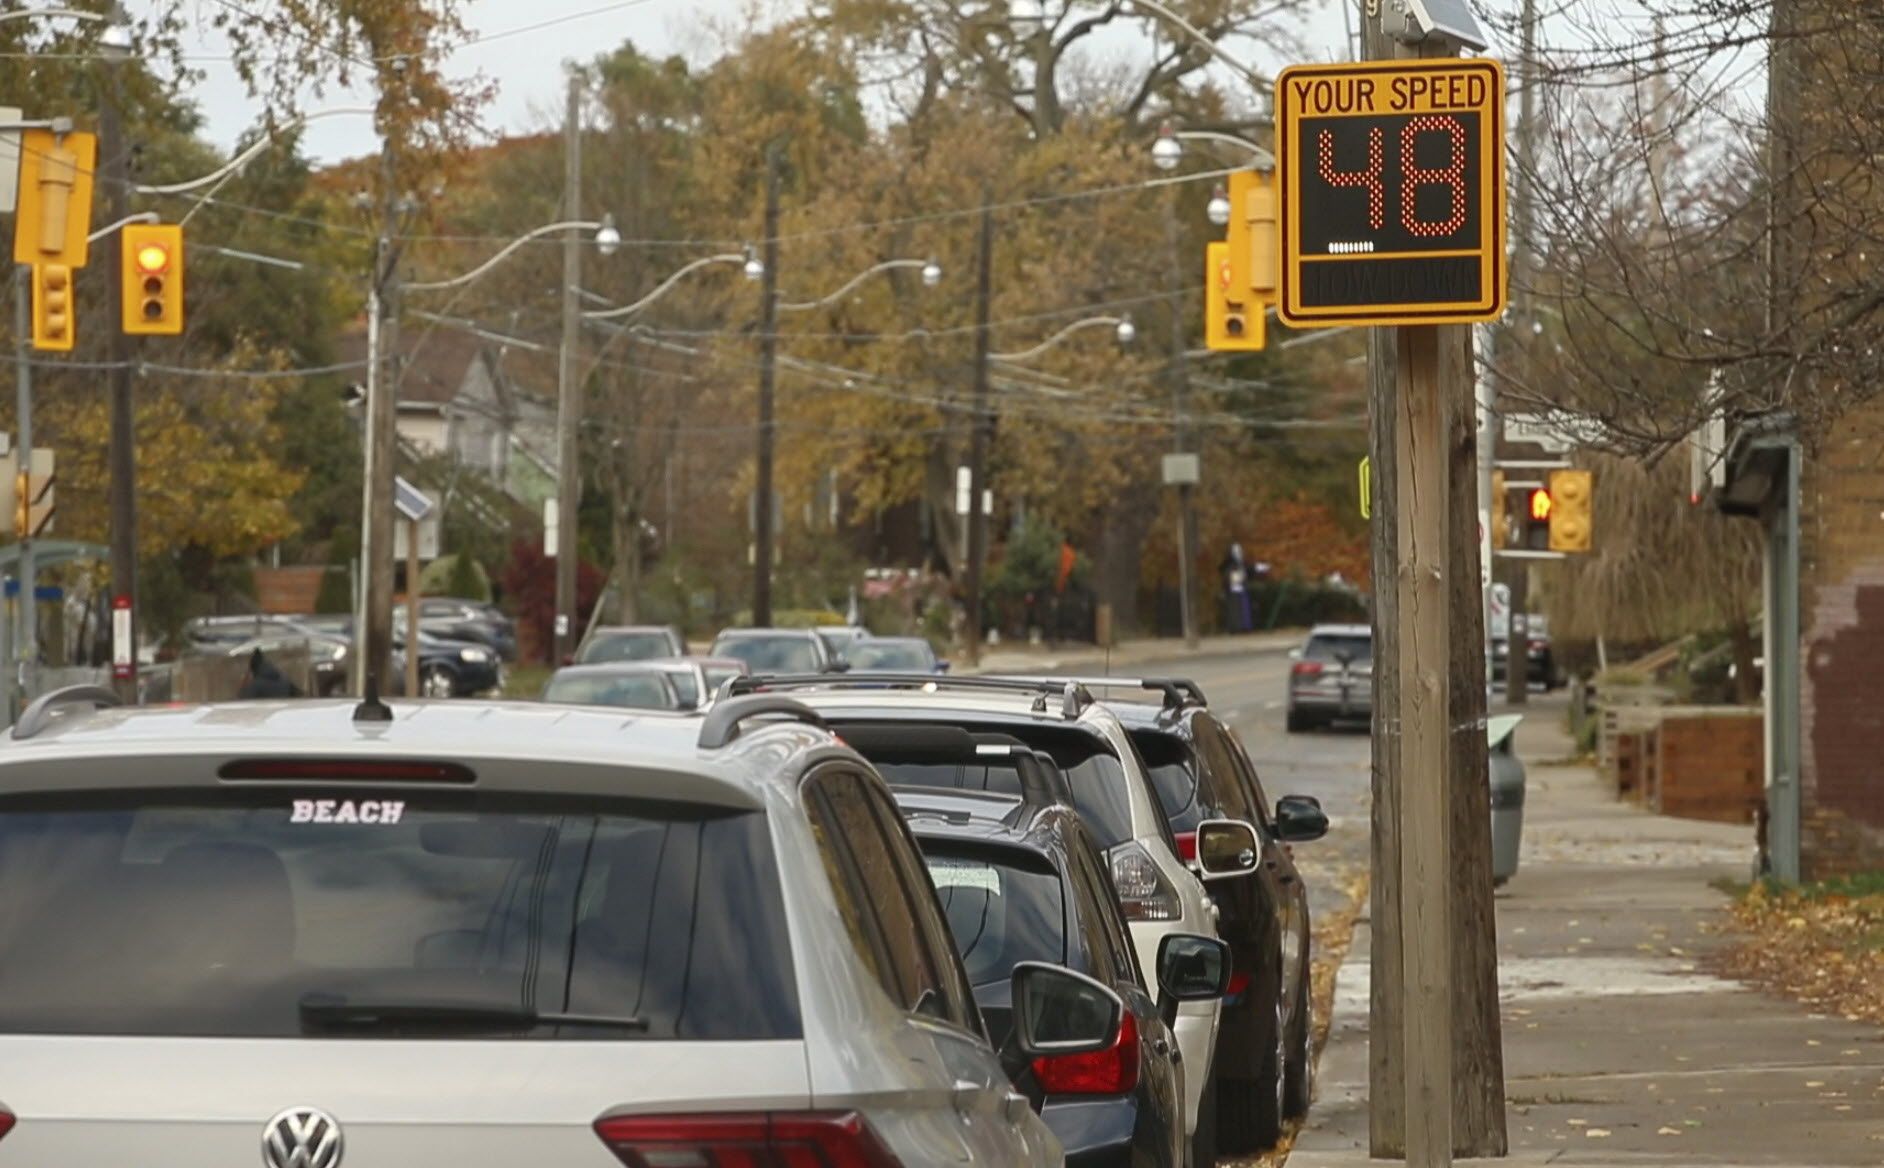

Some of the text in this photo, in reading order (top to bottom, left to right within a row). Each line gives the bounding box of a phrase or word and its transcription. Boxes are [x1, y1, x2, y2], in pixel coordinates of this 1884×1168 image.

[1294, 74, 1486, 114] YOUR SPEED
[1318, 115, 1465, 236] 48
[290, 799, 405, 824] BEACH
